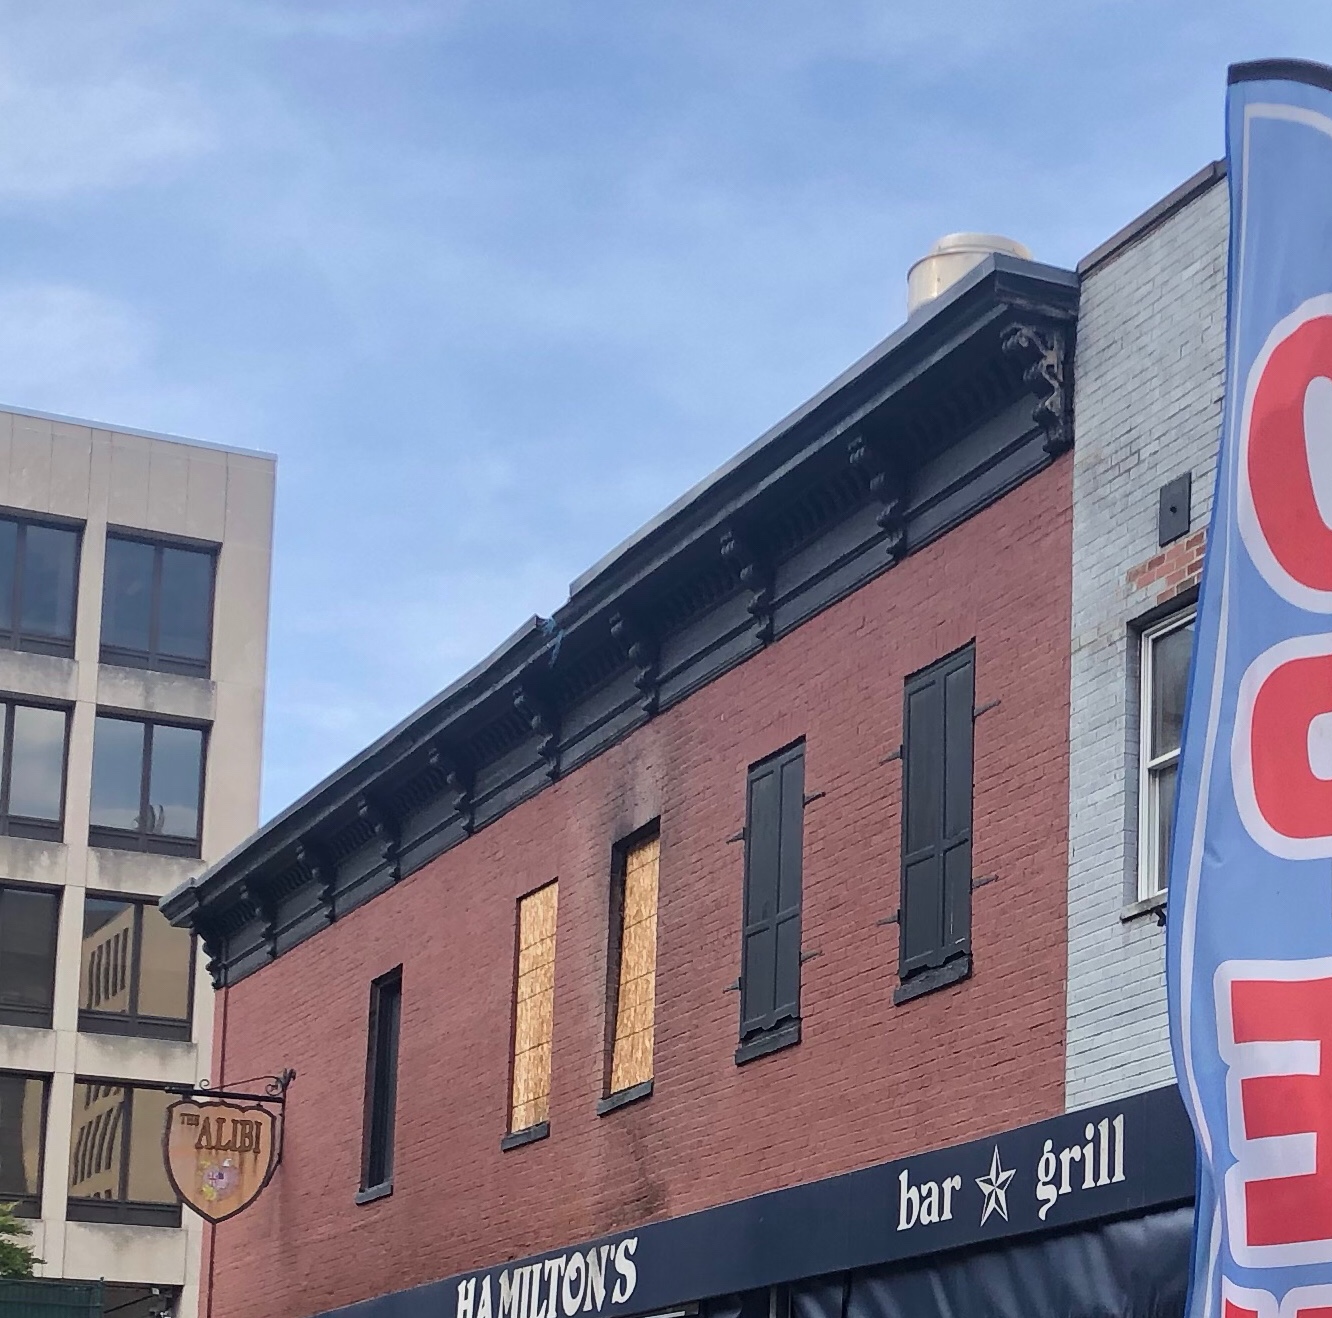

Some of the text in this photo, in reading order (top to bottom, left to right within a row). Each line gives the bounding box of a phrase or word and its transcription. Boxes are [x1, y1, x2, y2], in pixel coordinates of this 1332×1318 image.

[194, 1116, 262, 1154] ALIBI
[896, 1113, 1126, 1232] bar grill
